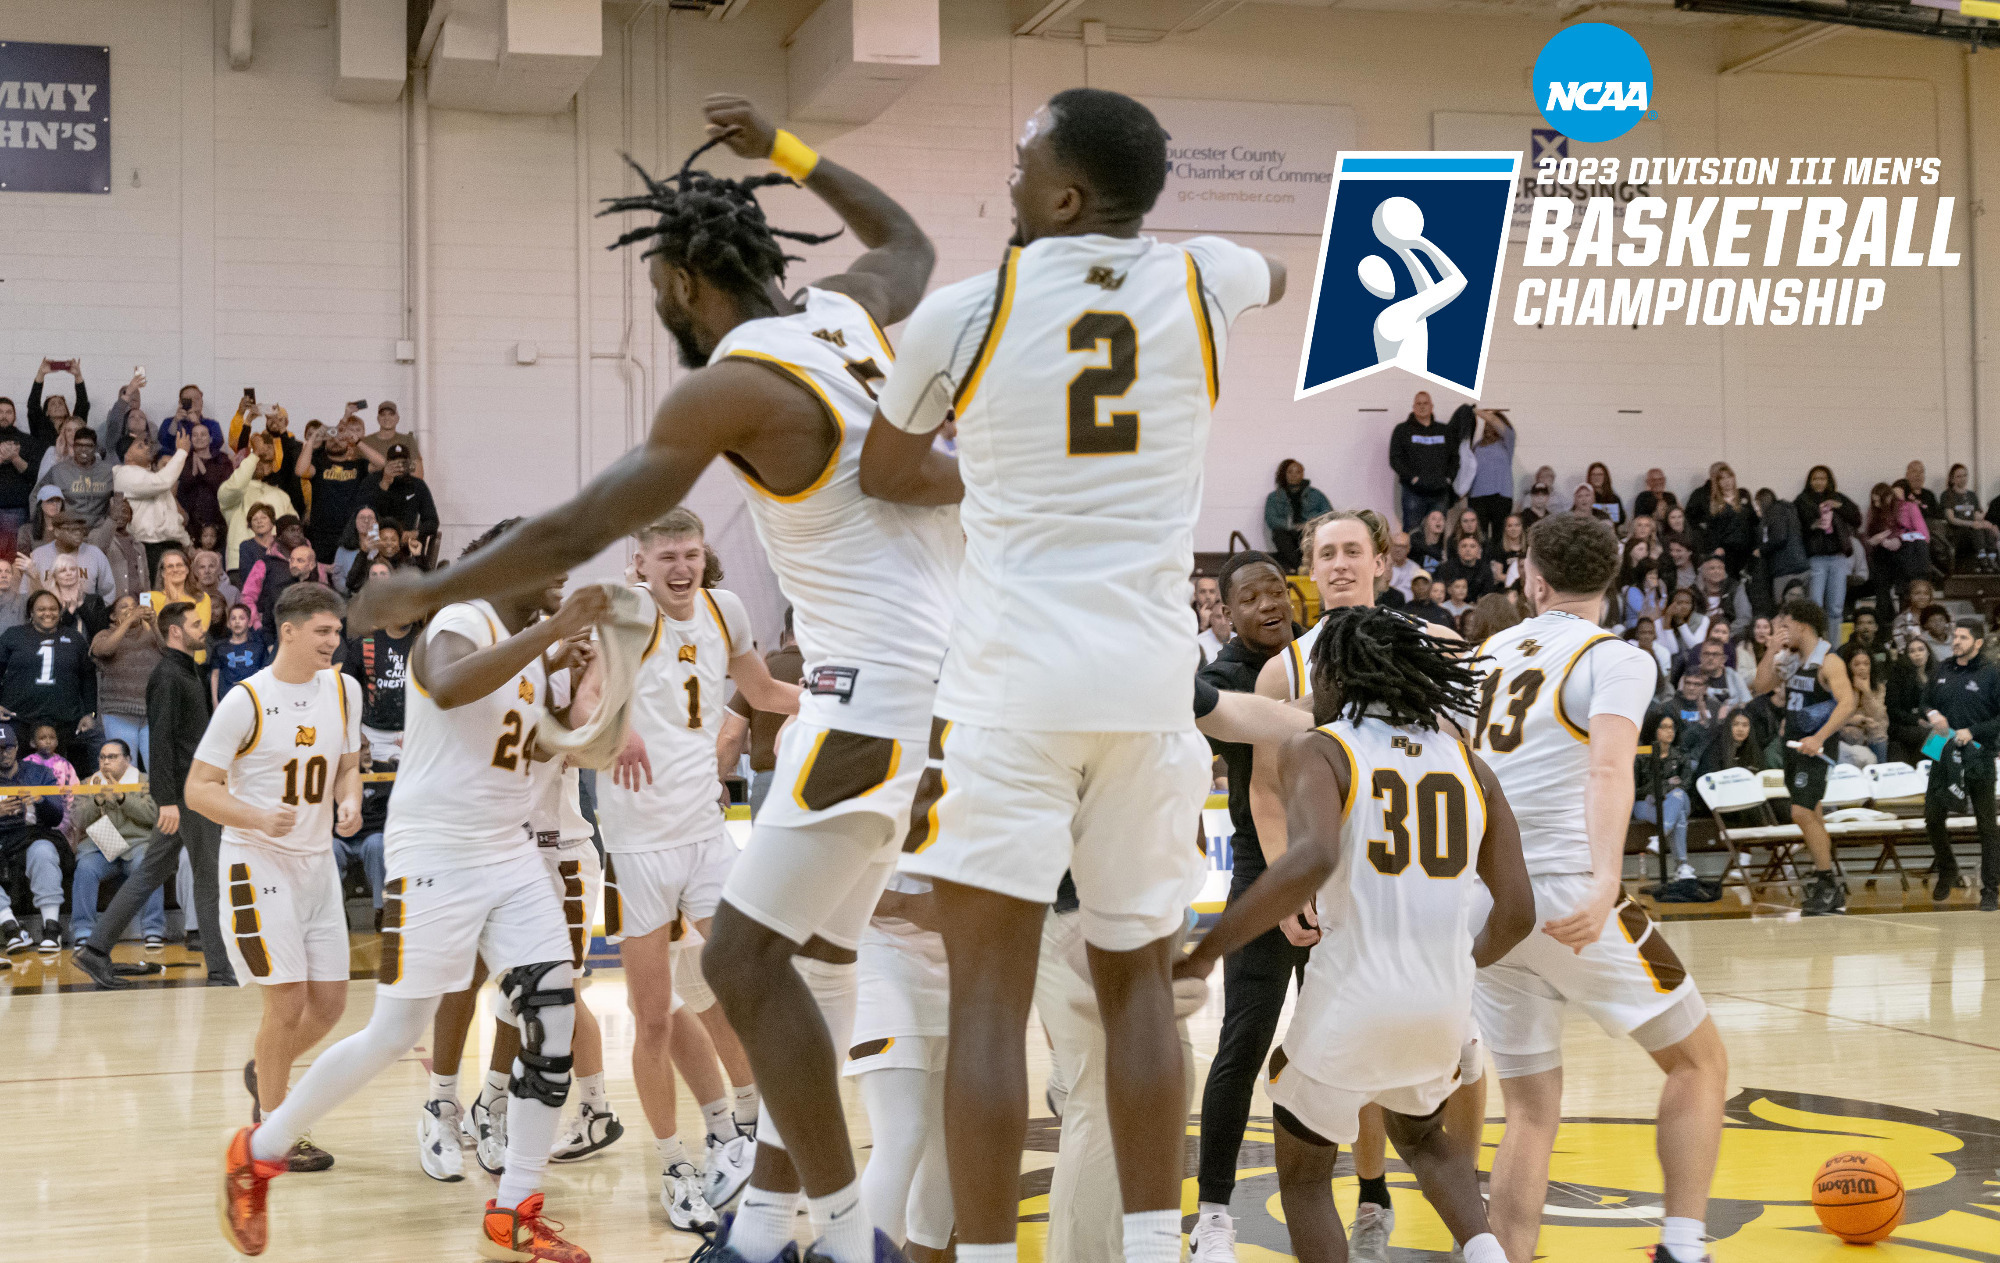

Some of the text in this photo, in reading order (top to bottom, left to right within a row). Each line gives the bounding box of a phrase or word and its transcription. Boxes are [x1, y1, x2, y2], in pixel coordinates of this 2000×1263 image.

[1175, 164, 1245, 181] Chamber
[1249, 165, 1265, 181] of
[1231, 146, 1286, 166] County
[1178, 189, 1295, 204] gc-chamber.com
[1066, 310, 1140, 458] 2
[35, 645, 56, 684] 1
[683, 675, 702, 729] 1
[1473, 667, 1546, 753] 13
[281, 755, 328, 806] 10
[1367, 768, 1469, 879] 30
[1817, 1177, 1878, 1195] Wilson
